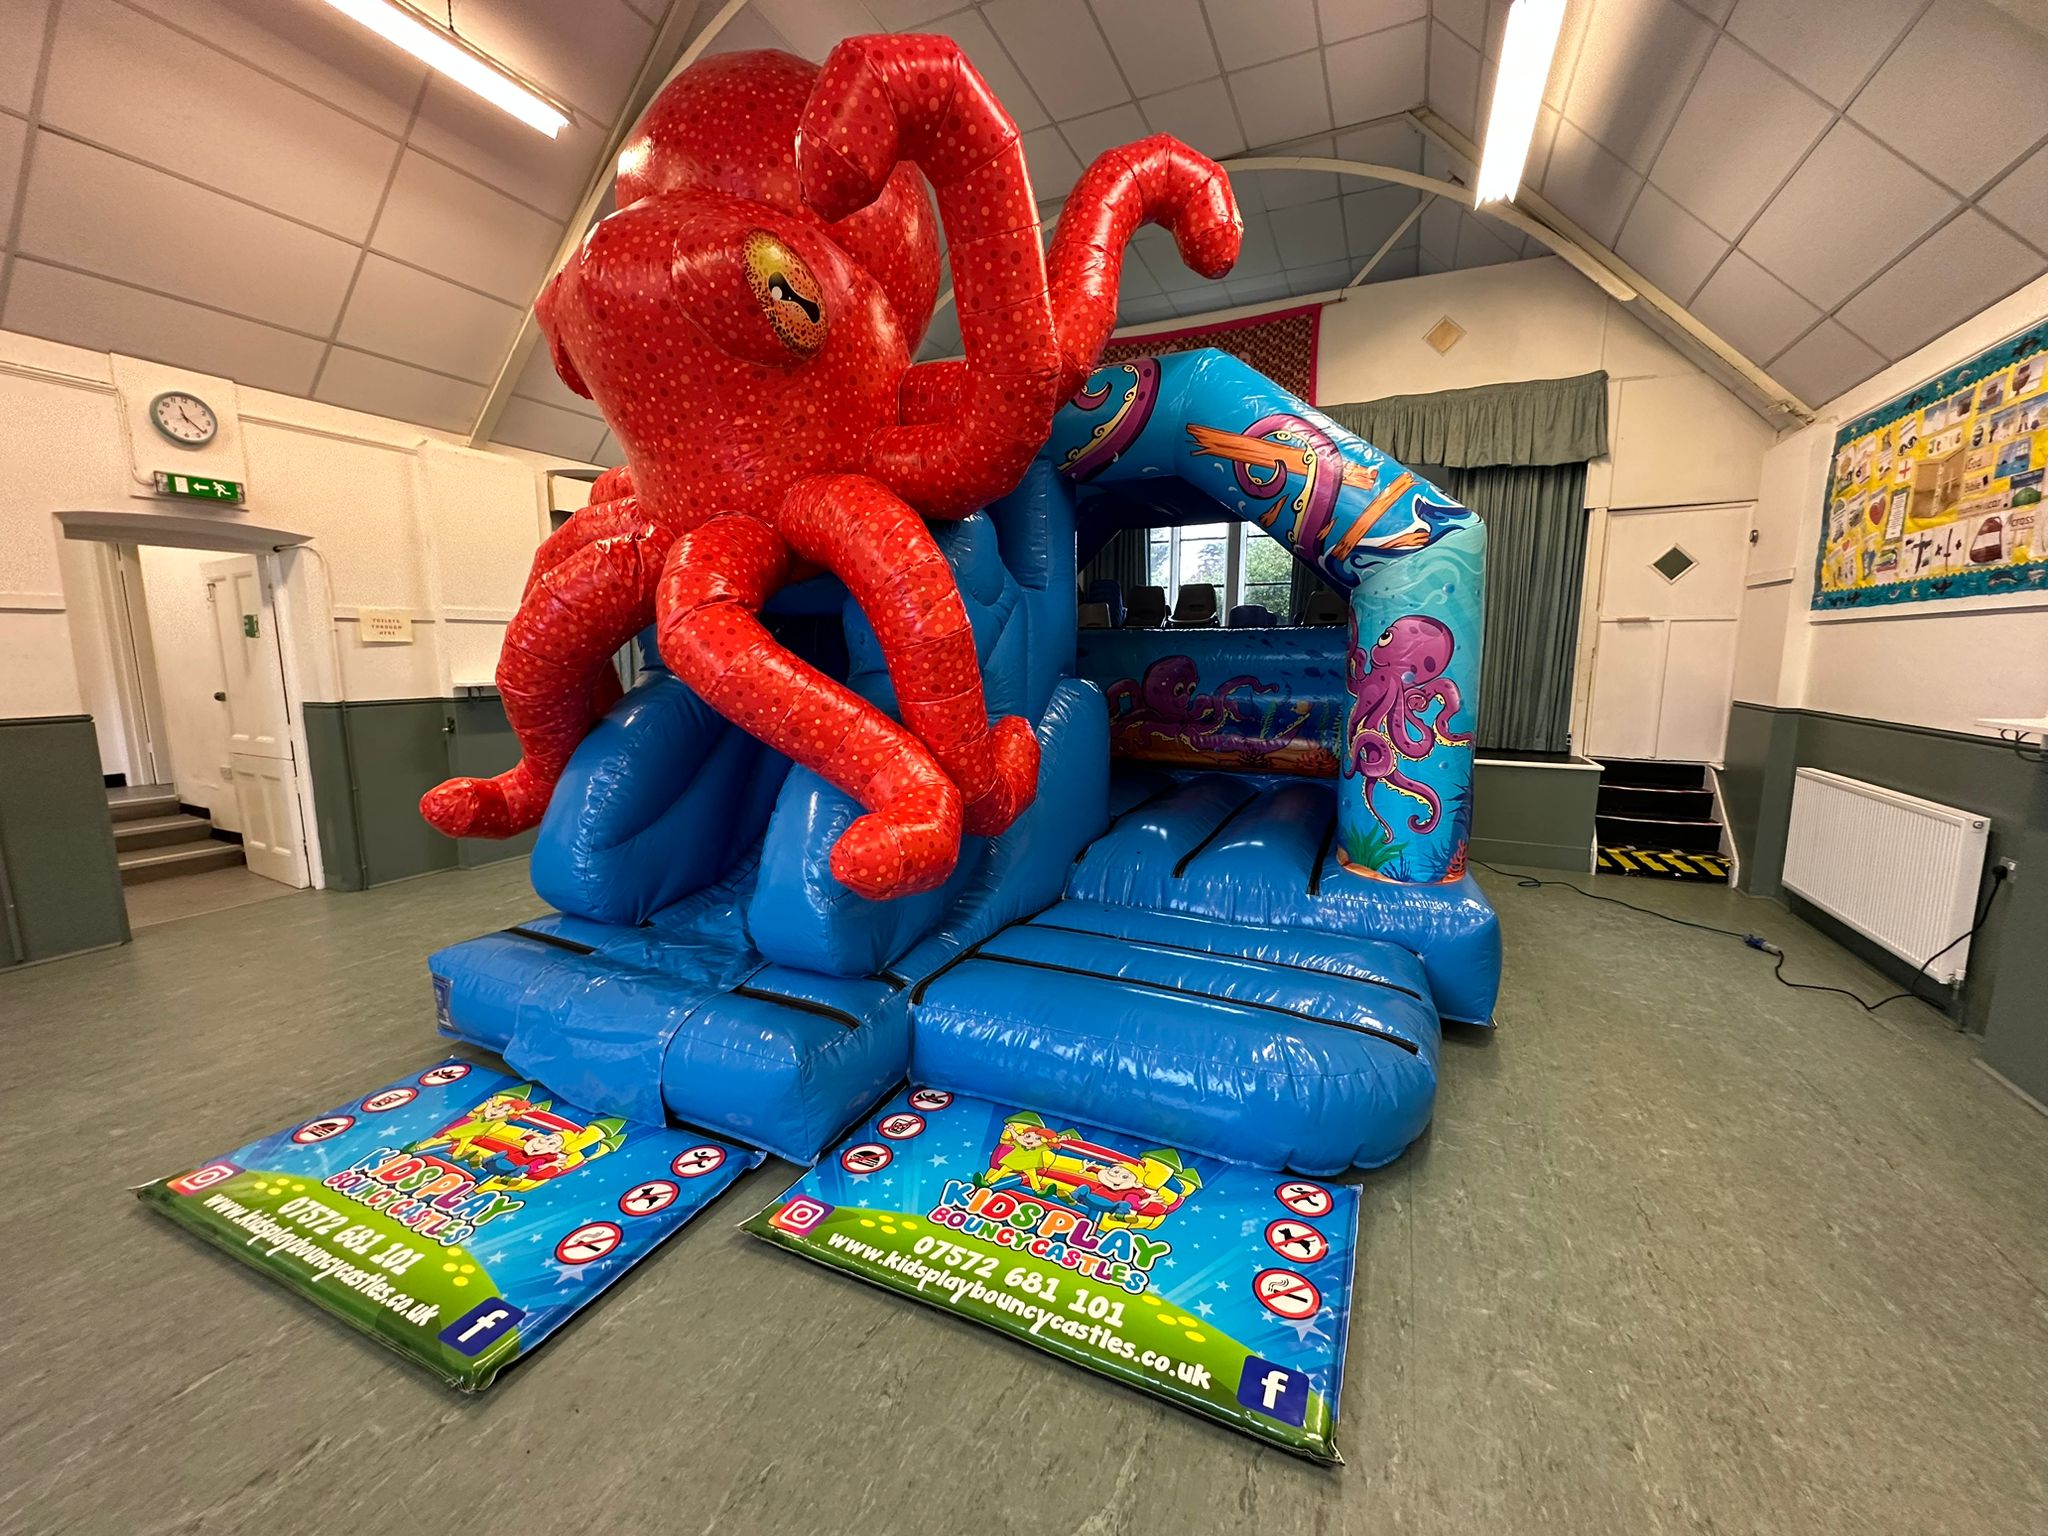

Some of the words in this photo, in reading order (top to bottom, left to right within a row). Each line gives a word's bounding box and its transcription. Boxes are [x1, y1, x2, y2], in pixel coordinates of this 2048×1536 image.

[1928, 432, 1961, 454] Jes
[2010, 515, 2035, 527] cross
[203, 1193, 440, 1327] www.kidsplaybouncycastles.co.uk
[277, 1196, 349, 1235] 07572
[333, 1225, 386, 1255] 681
[369, 1242, 425, 1276] 101
[929, 1206, 1034, 1250] BOUNCY
[1030, 1238, 1147, 1292] CASTLES
[828, 1232, 1212, 1390] www.kidsplaybouncycastles.co.uk
[913, 1236, 999, 1279] 07572
[1004, 1267, 1060, 1303] 681
[1068, 1288, 1125, 1328] 101
[1260, 1370, 1289, 1410] f
